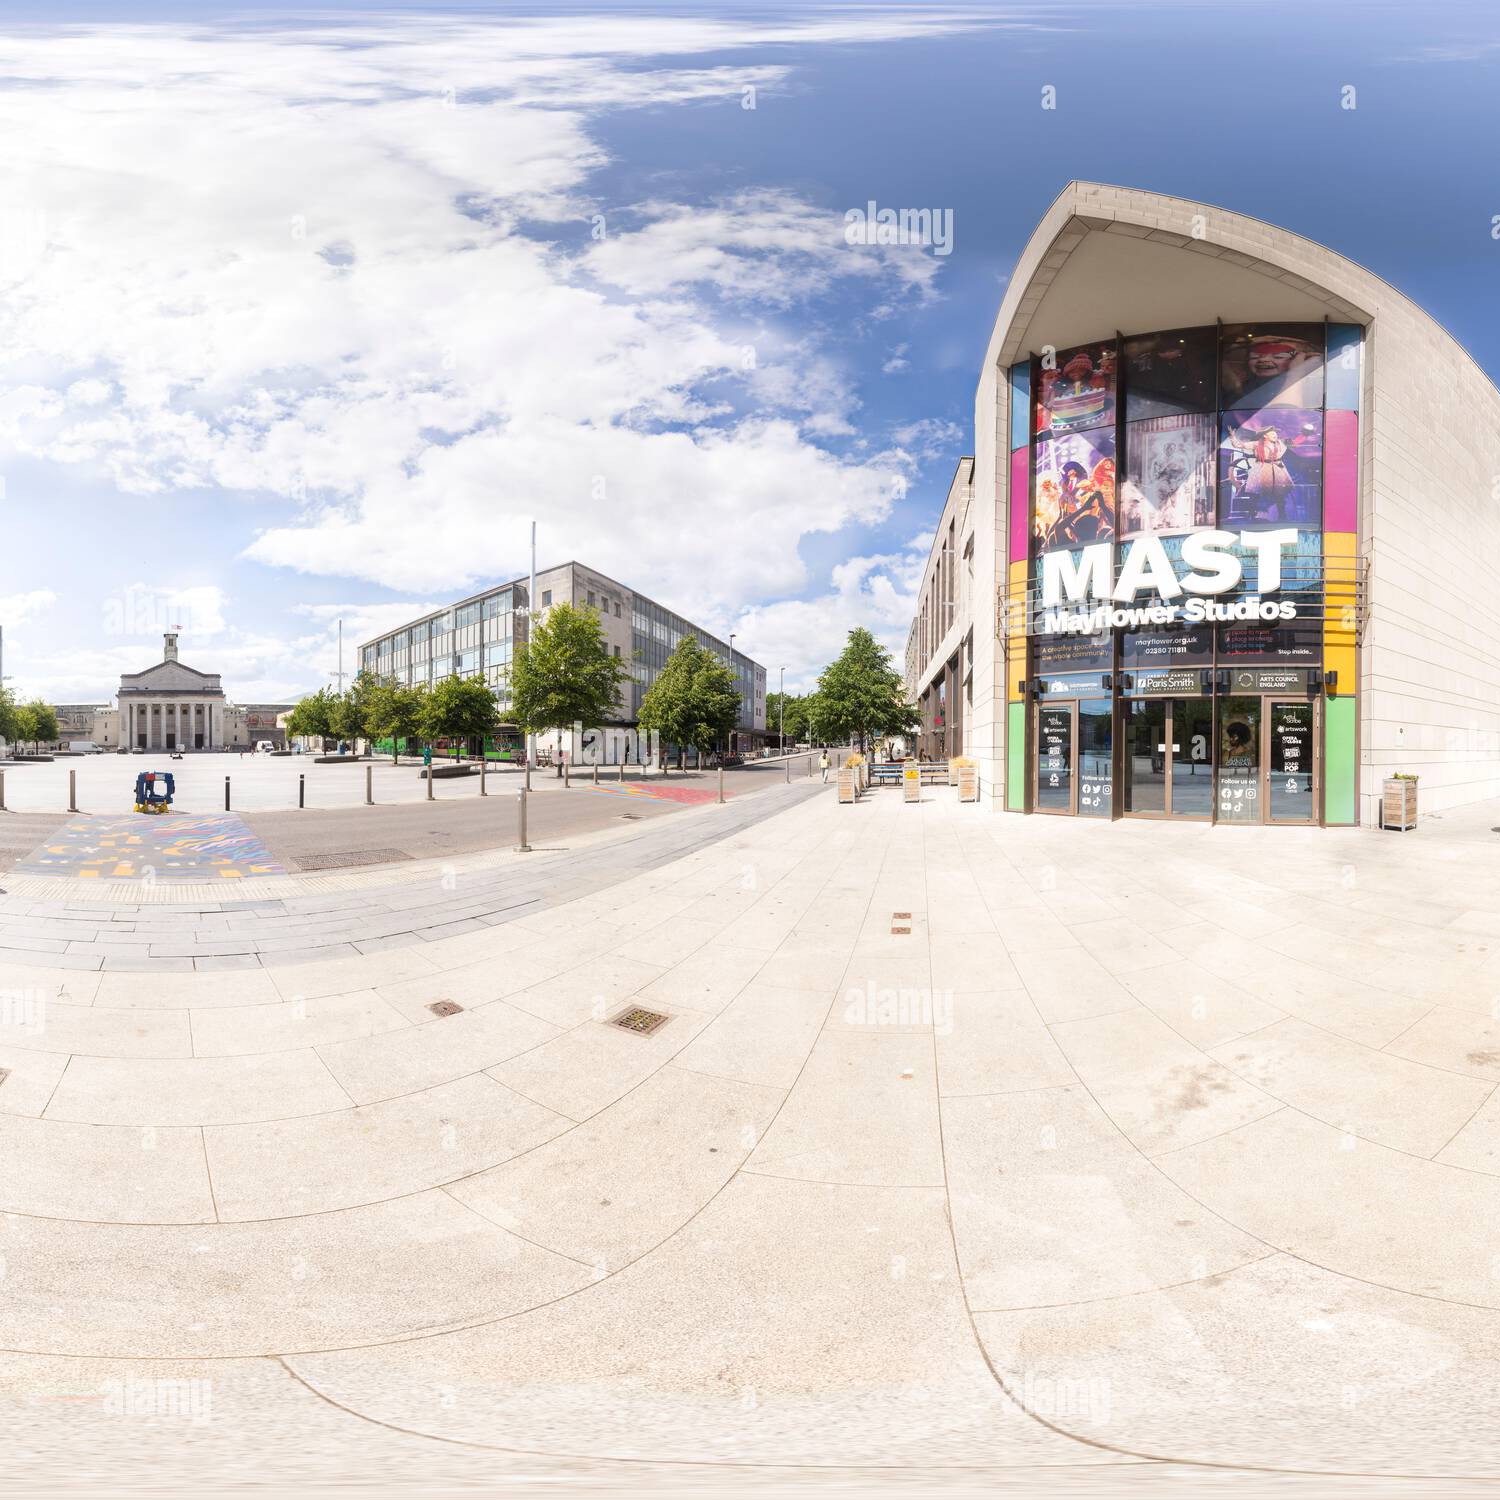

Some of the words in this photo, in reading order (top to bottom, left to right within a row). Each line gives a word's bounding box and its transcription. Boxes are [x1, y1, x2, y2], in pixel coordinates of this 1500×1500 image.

[1043, 528, 1298, 608] MAST
[1044, 603, 1180, 635] Mayflower
[1183, 597, 1297, 622] Studios
[1136, 636, 1198, 646] mayflower.org.uk
[1072, 649, 1108, 658] community
[1147, 679, 1168, 688] Paris
[1168, 678, 1194, 688] Smith
